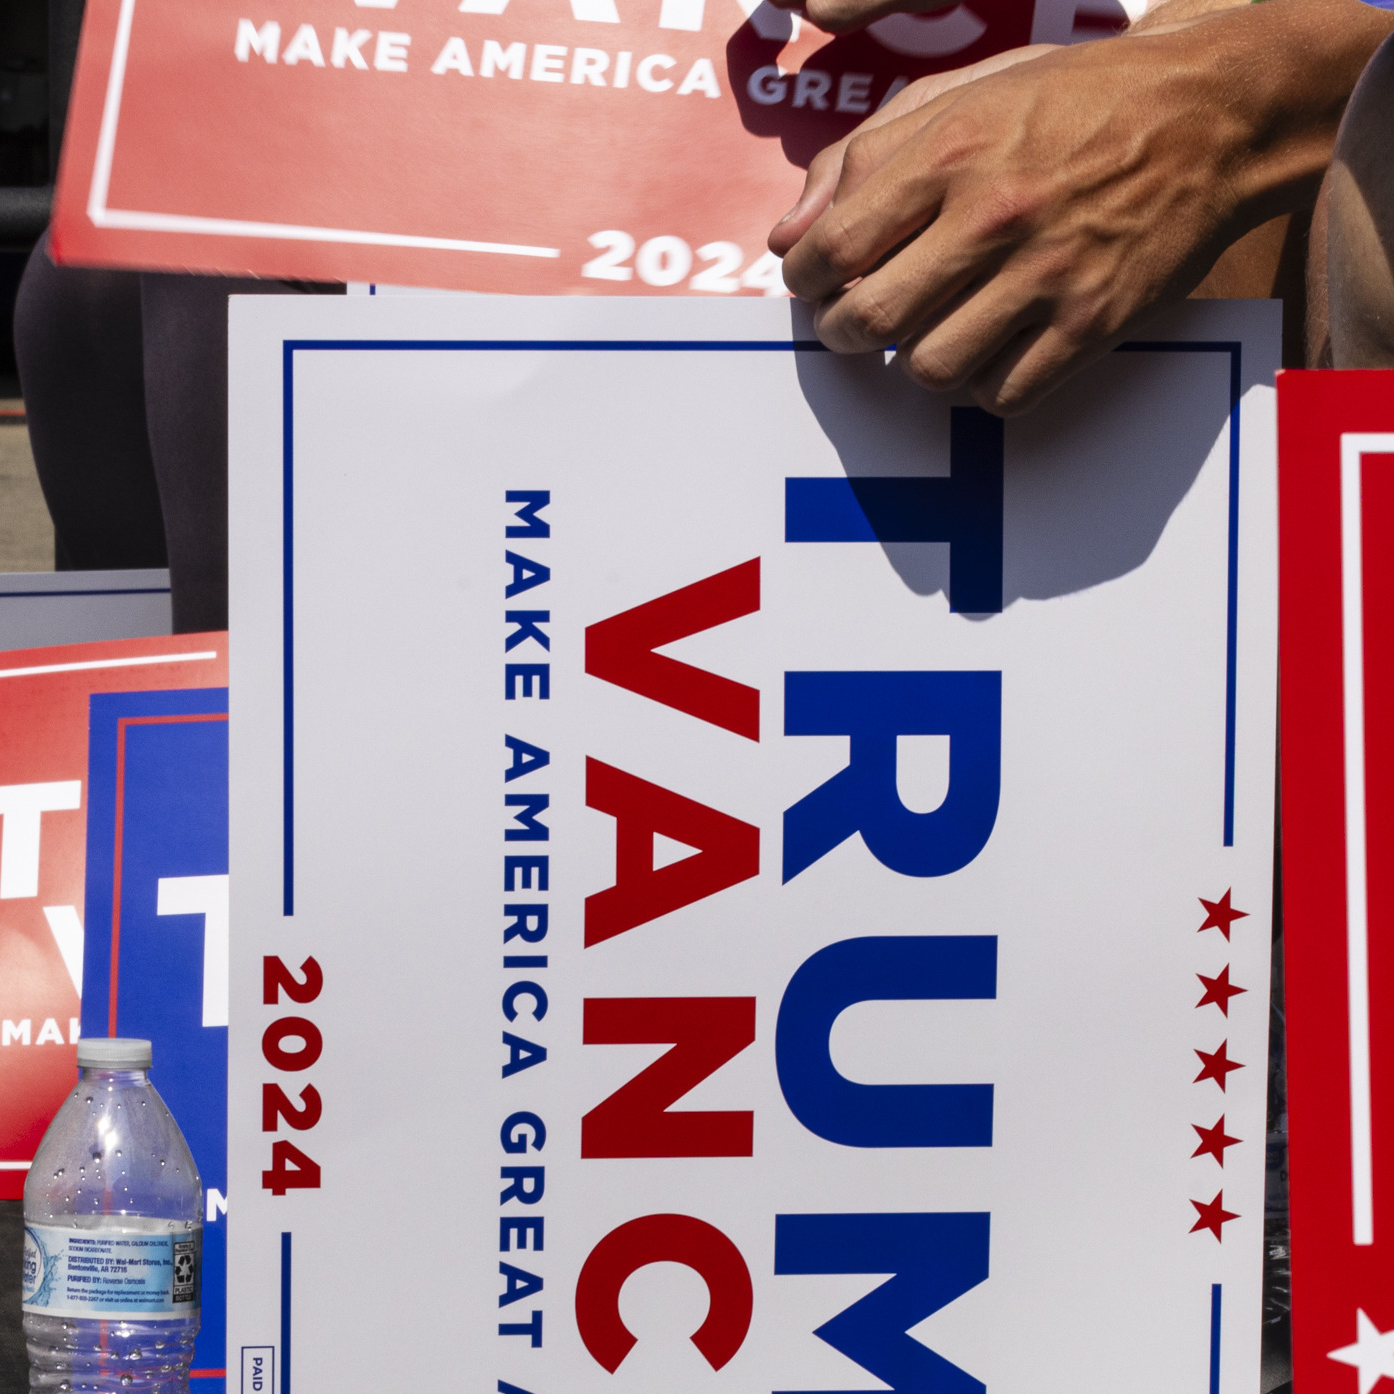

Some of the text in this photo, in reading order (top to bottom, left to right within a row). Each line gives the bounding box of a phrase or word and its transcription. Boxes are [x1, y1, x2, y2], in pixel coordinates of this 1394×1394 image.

[234, 18, 412, 73] MAKE
[430, 36, 722, 99] AMERICA
[746, 65, 910, 115] GRE
[580, 229, 784, 298] 2024
[504, 489, 551, 701] MAKE
[501, 733, 550, 1079] AMERICA
[262, 955, 323, 1196] 2024
[68, 1256, 104, 1265] DISTRIBUTED
[115, 1258, 141, 1266] Wal-Mart
[142, 1259, 162, 1267] Stores,
[68, 1263, 99, 1273] Bentonville,
[497, 1110, 547, 1349] GREAT
[67, 1275, 92, 1283] PURIFIED
[253, 1357, 263, 1392] PAID
